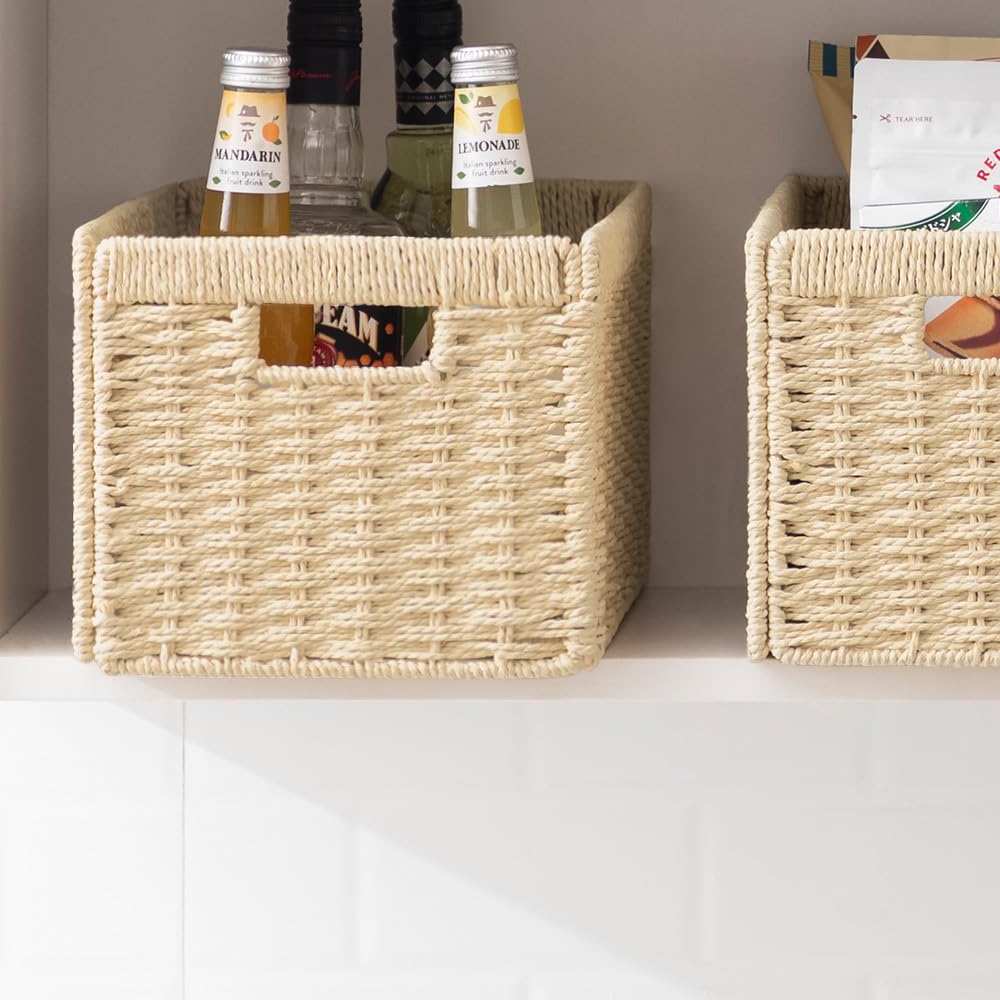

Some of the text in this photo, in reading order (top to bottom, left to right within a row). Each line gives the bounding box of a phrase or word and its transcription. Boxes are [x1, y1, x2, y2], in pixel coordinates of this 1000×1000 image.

[458, 139, 521, 155] LEMONADE
[214, 148, 282, 163] MANDARIN
[486, 159, 517, 168] sparkling
[241, 169, 273, 180] sparkling
[490, 168, 508, 176] drink
[244, 178, 263, 186] drink
[317, 304, 380, 354] EAM
